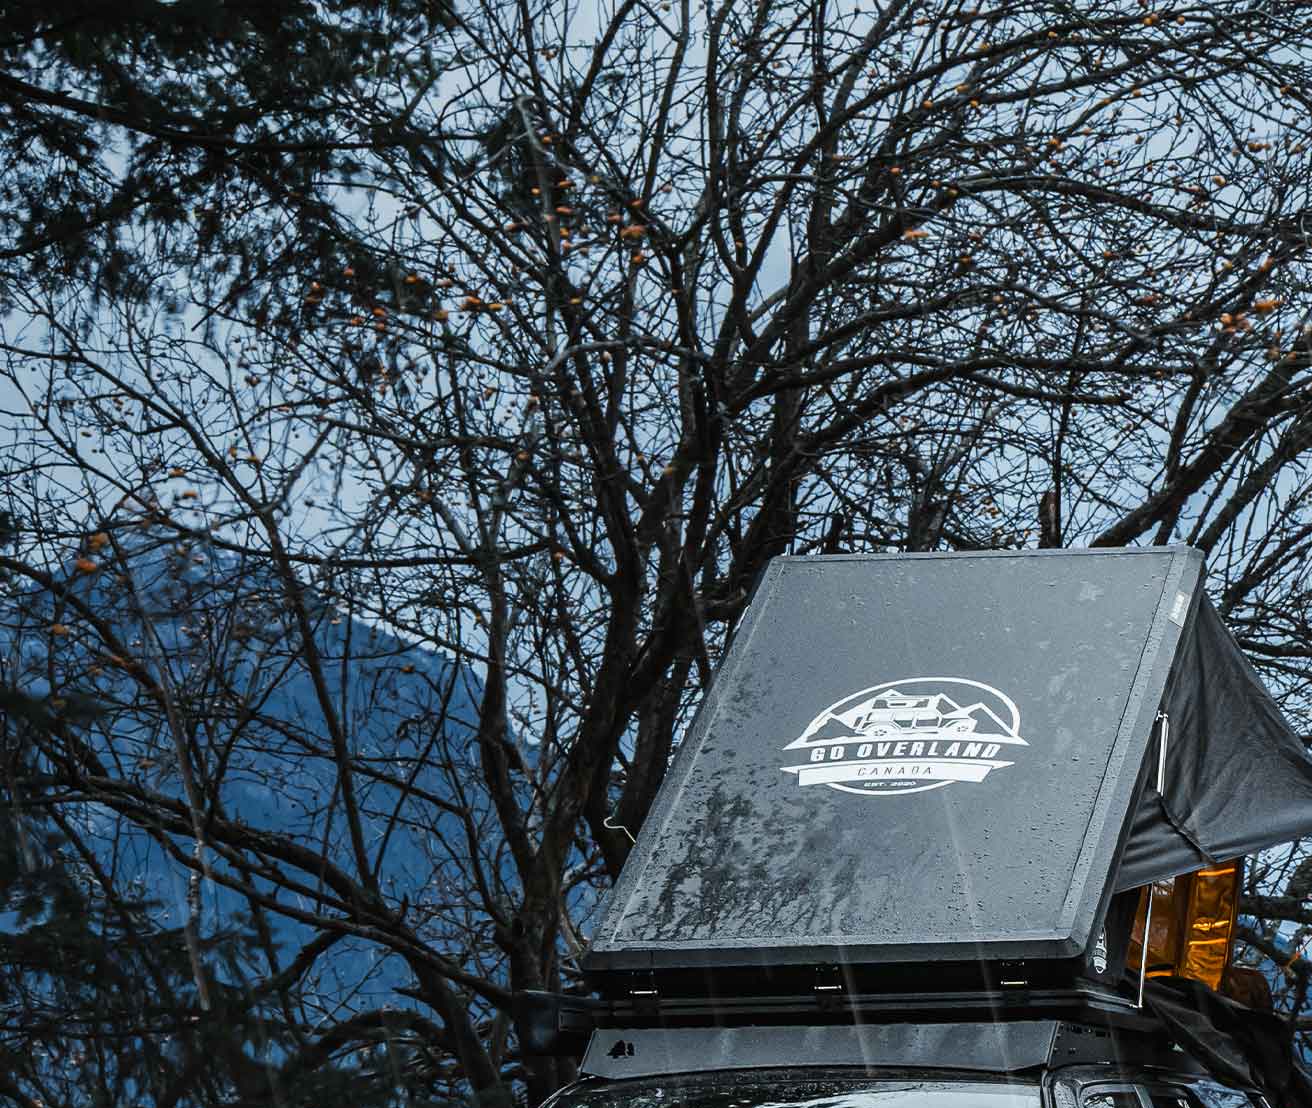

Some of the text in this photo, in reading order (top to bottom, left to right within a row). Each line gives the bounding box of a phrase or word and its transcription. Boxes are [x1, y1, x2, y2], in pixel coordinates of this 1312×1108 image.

[810, 741, 1001, 761] GO OVERLAND
[857, 766, 933, 776] CANADA
